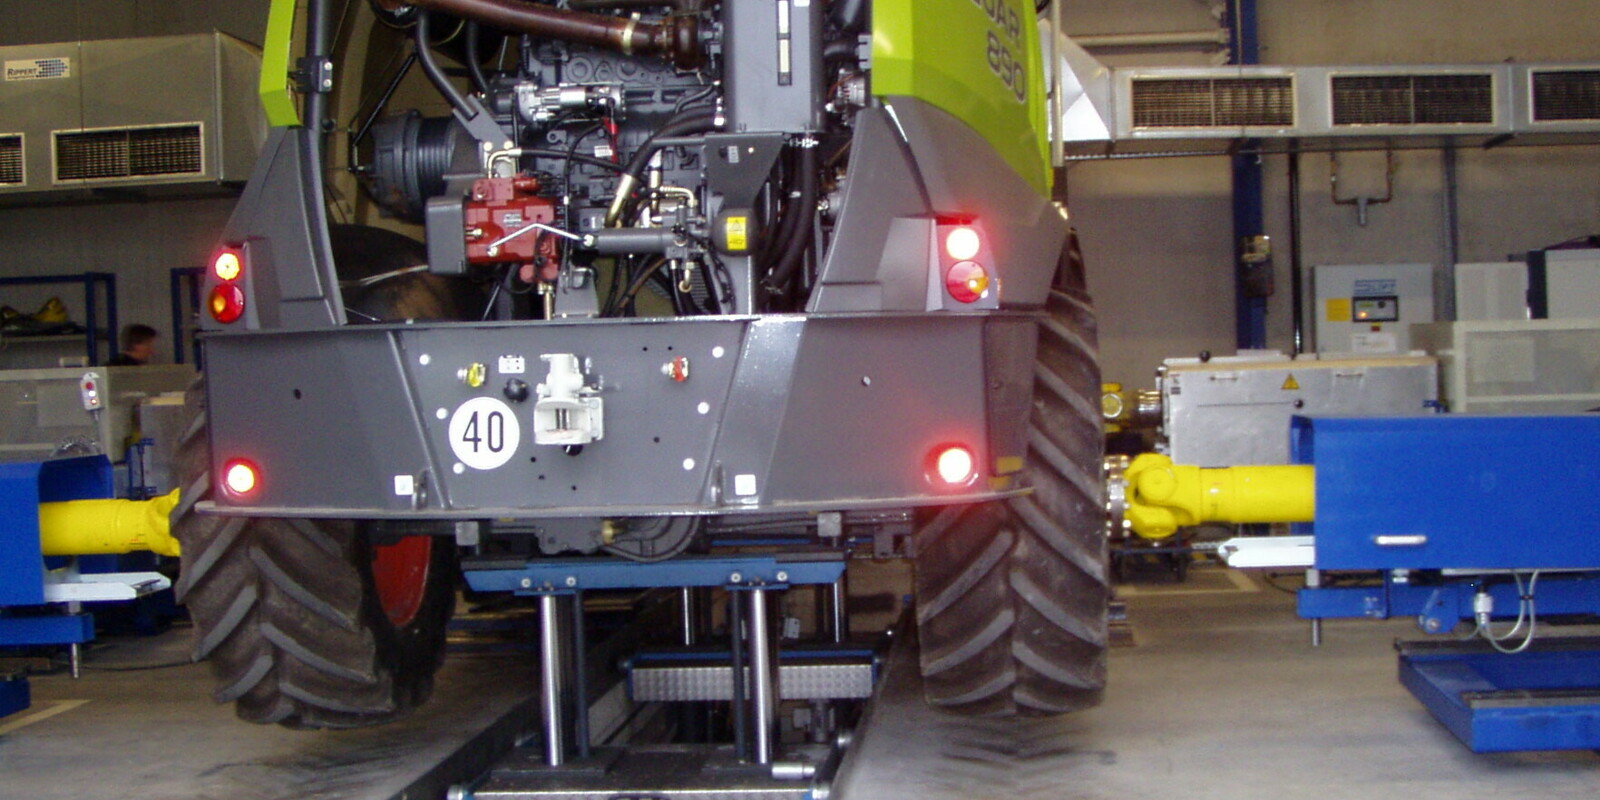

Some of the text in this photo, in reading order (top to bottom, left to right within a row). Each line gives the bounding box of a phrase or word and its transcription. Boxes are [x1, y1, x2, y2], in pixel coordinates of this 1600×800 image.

[972, 0, 1021, 47] UAR
[987, 30, 1025, 102] 890
[463, 411, 504, 452] 40
